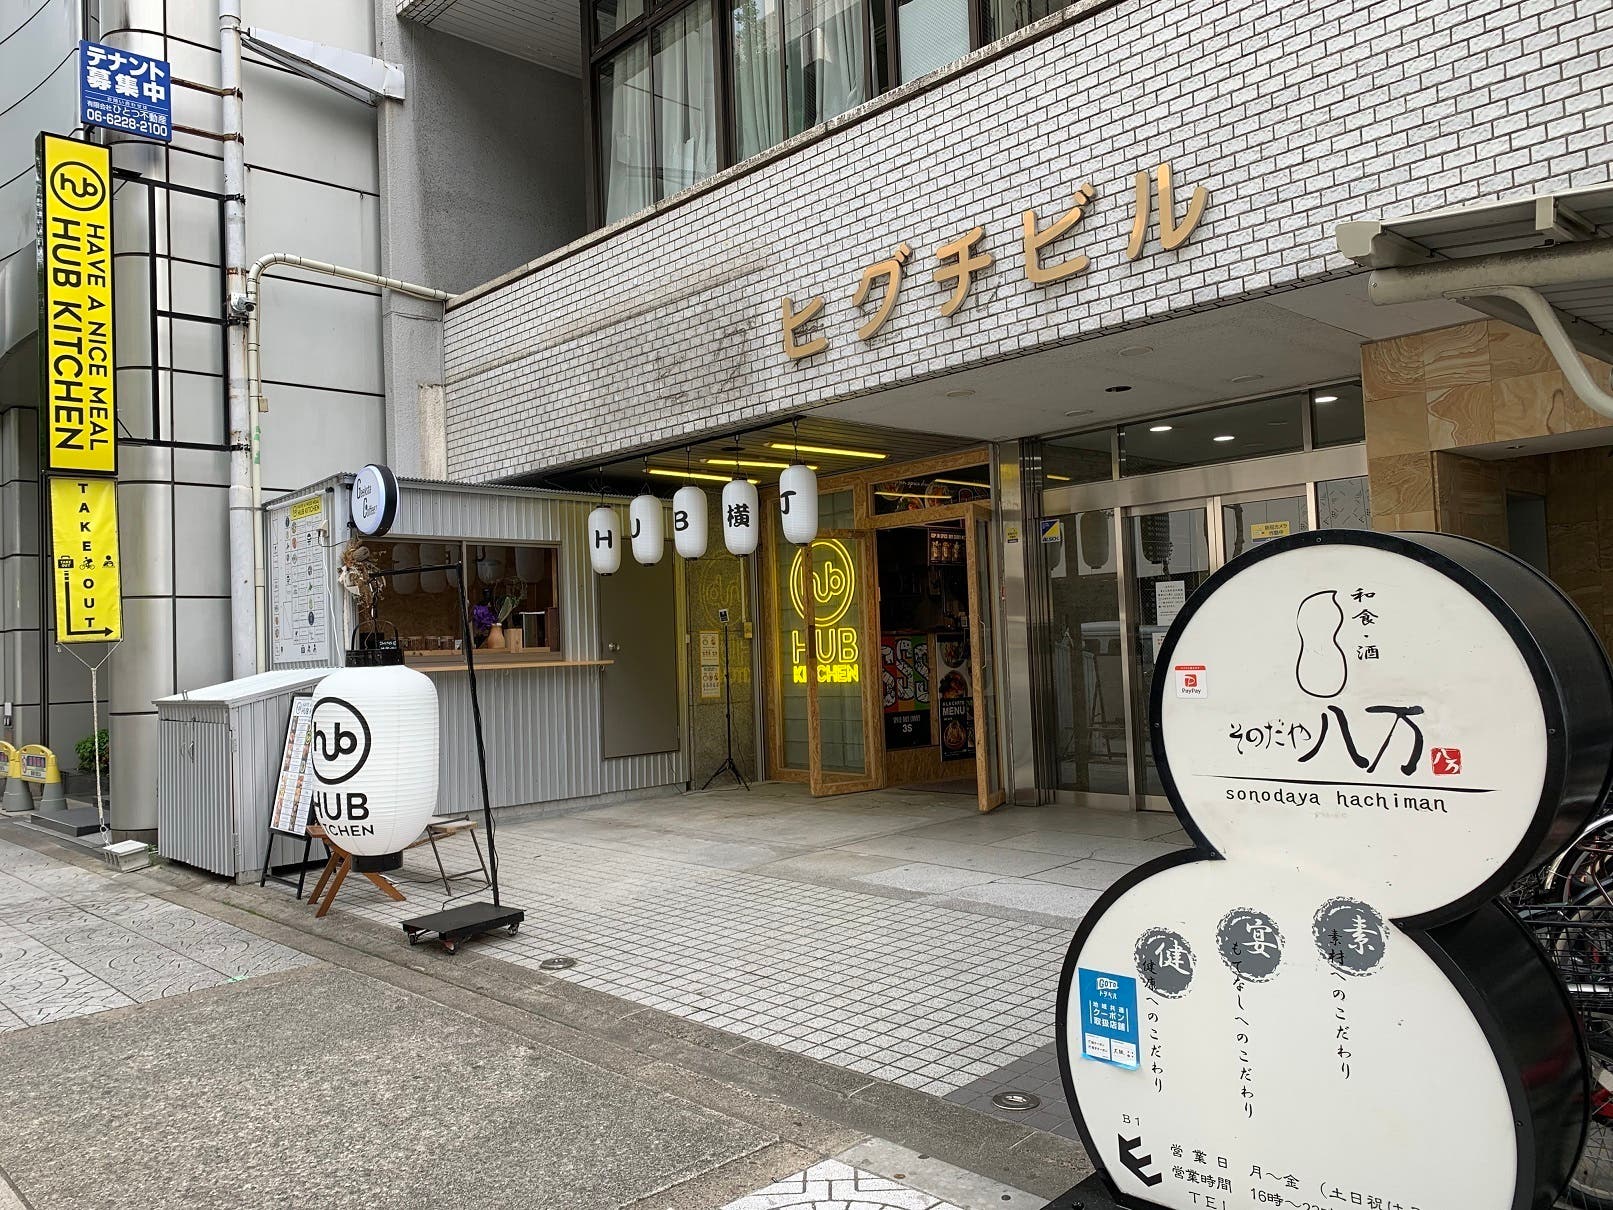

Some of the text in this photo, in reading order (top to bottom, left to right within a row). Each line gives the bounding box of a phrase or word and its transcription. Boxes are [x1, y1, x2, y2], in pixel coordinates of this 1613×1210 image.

[86, 45, 165, 81] テナント
[86, 65, 165, 102] 募集中
[86, 108, 168, 136] 06-6228-2100
[783, 163, 1209, 359] ヒグチビル
[52, 216, 84, 450] HUB KITCHEN
[87, 223, 109, 451] HAVE A NICE MEAL
[793, 665, 860, 683] KICHEN
[942, 706, 966, 716] MENU
[1226, 787, 1448, 813] sonodaya hachiman
[1241, 918, 1277, 958] 宴
[1342, 914, 1378, 955] 素
[1155, 940, 1191, 975] 健
[1092, 1009, 1125, 1021] クーポン
[1172, 1165, 1232, 1193] 営業時間
